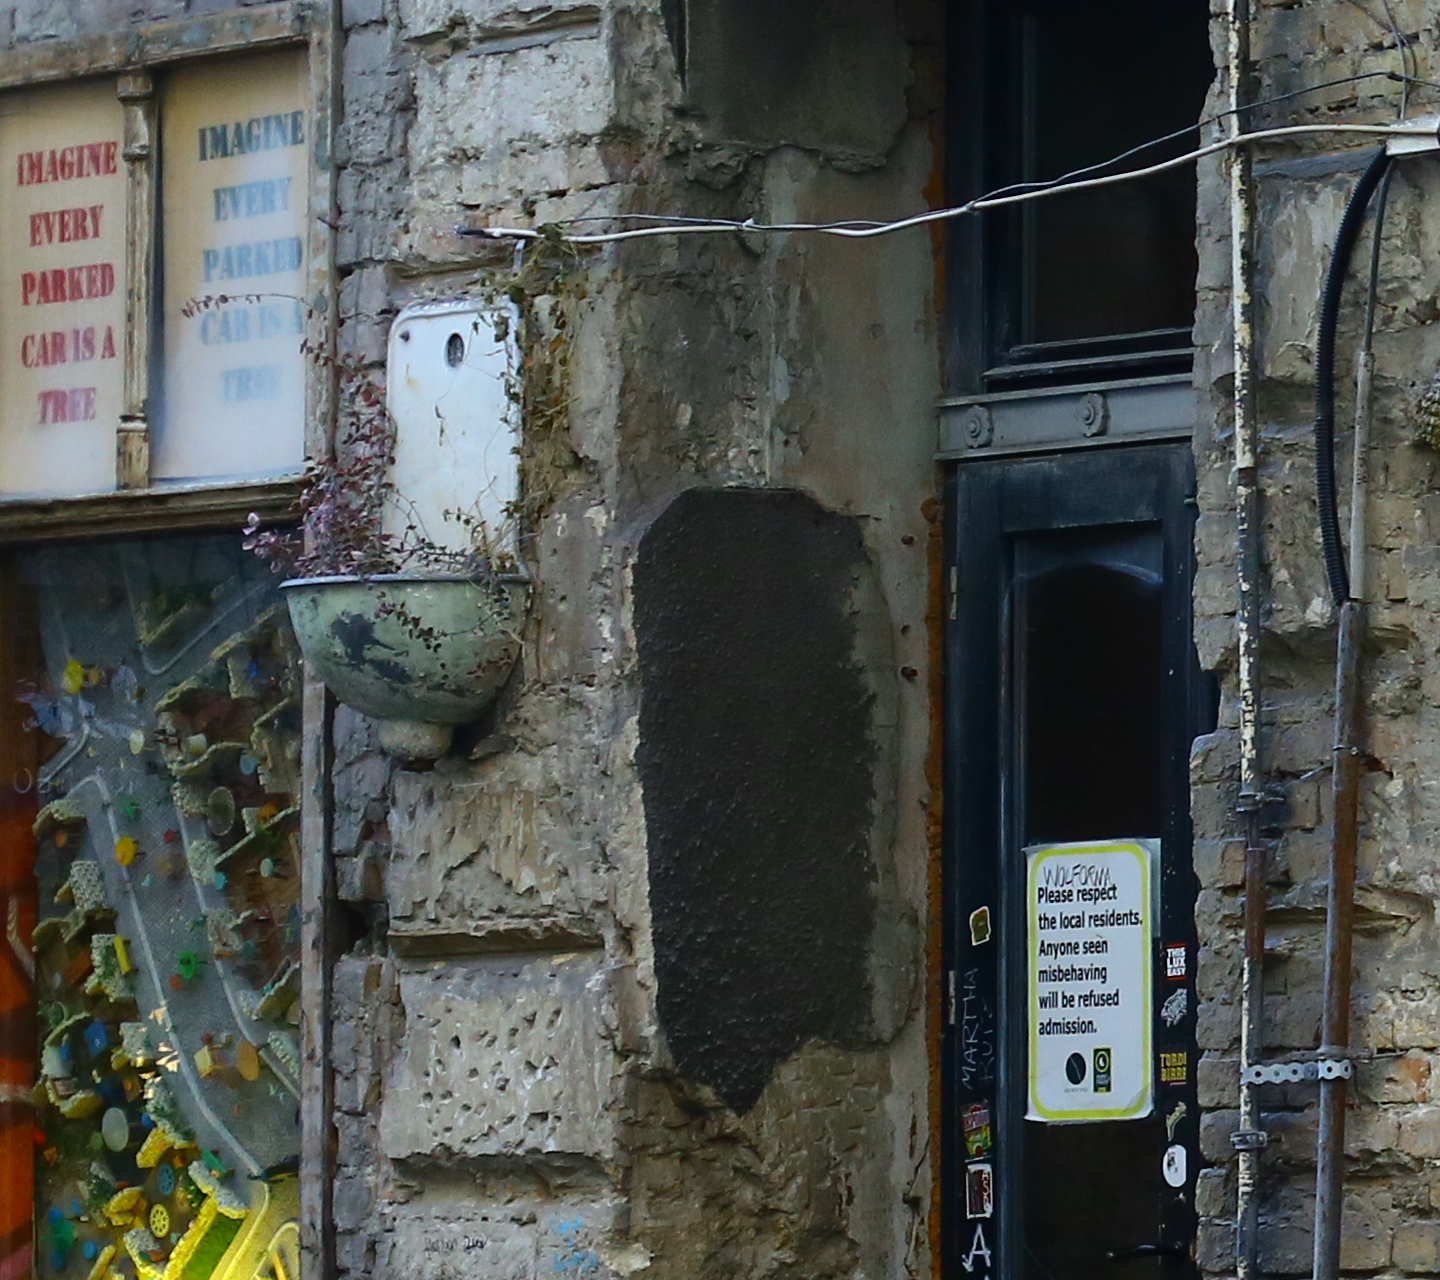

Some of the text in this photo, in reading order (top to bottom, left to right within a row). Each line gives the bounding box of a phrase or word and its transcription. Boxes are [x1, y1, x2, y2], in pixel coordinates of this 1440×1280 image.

[198, 110, 305, 162] IMAGINE
[17, 141, 118, 186] IMAGINE
[213, 177, 292, 222] EVERY
[29, 204, 104, 247] EVERY
[202, 236, 302, 282] PARKED
[21, 263, 115, 306] PARKED
[21, 324, 116, 368] CAR IS A
[38, 387, 96, 425] TREE
[1037, 884, 1117, 905] Please respect
[1038, 910, 1143, 930] the local residents.
[1038, 939, 1108, 959] Anyone seen
[1038, 964, 1107, 985] misbehaving
[1038, 989, 1120, 1009] will be refused
[1038, 1018, 1097, 1037] admission.
